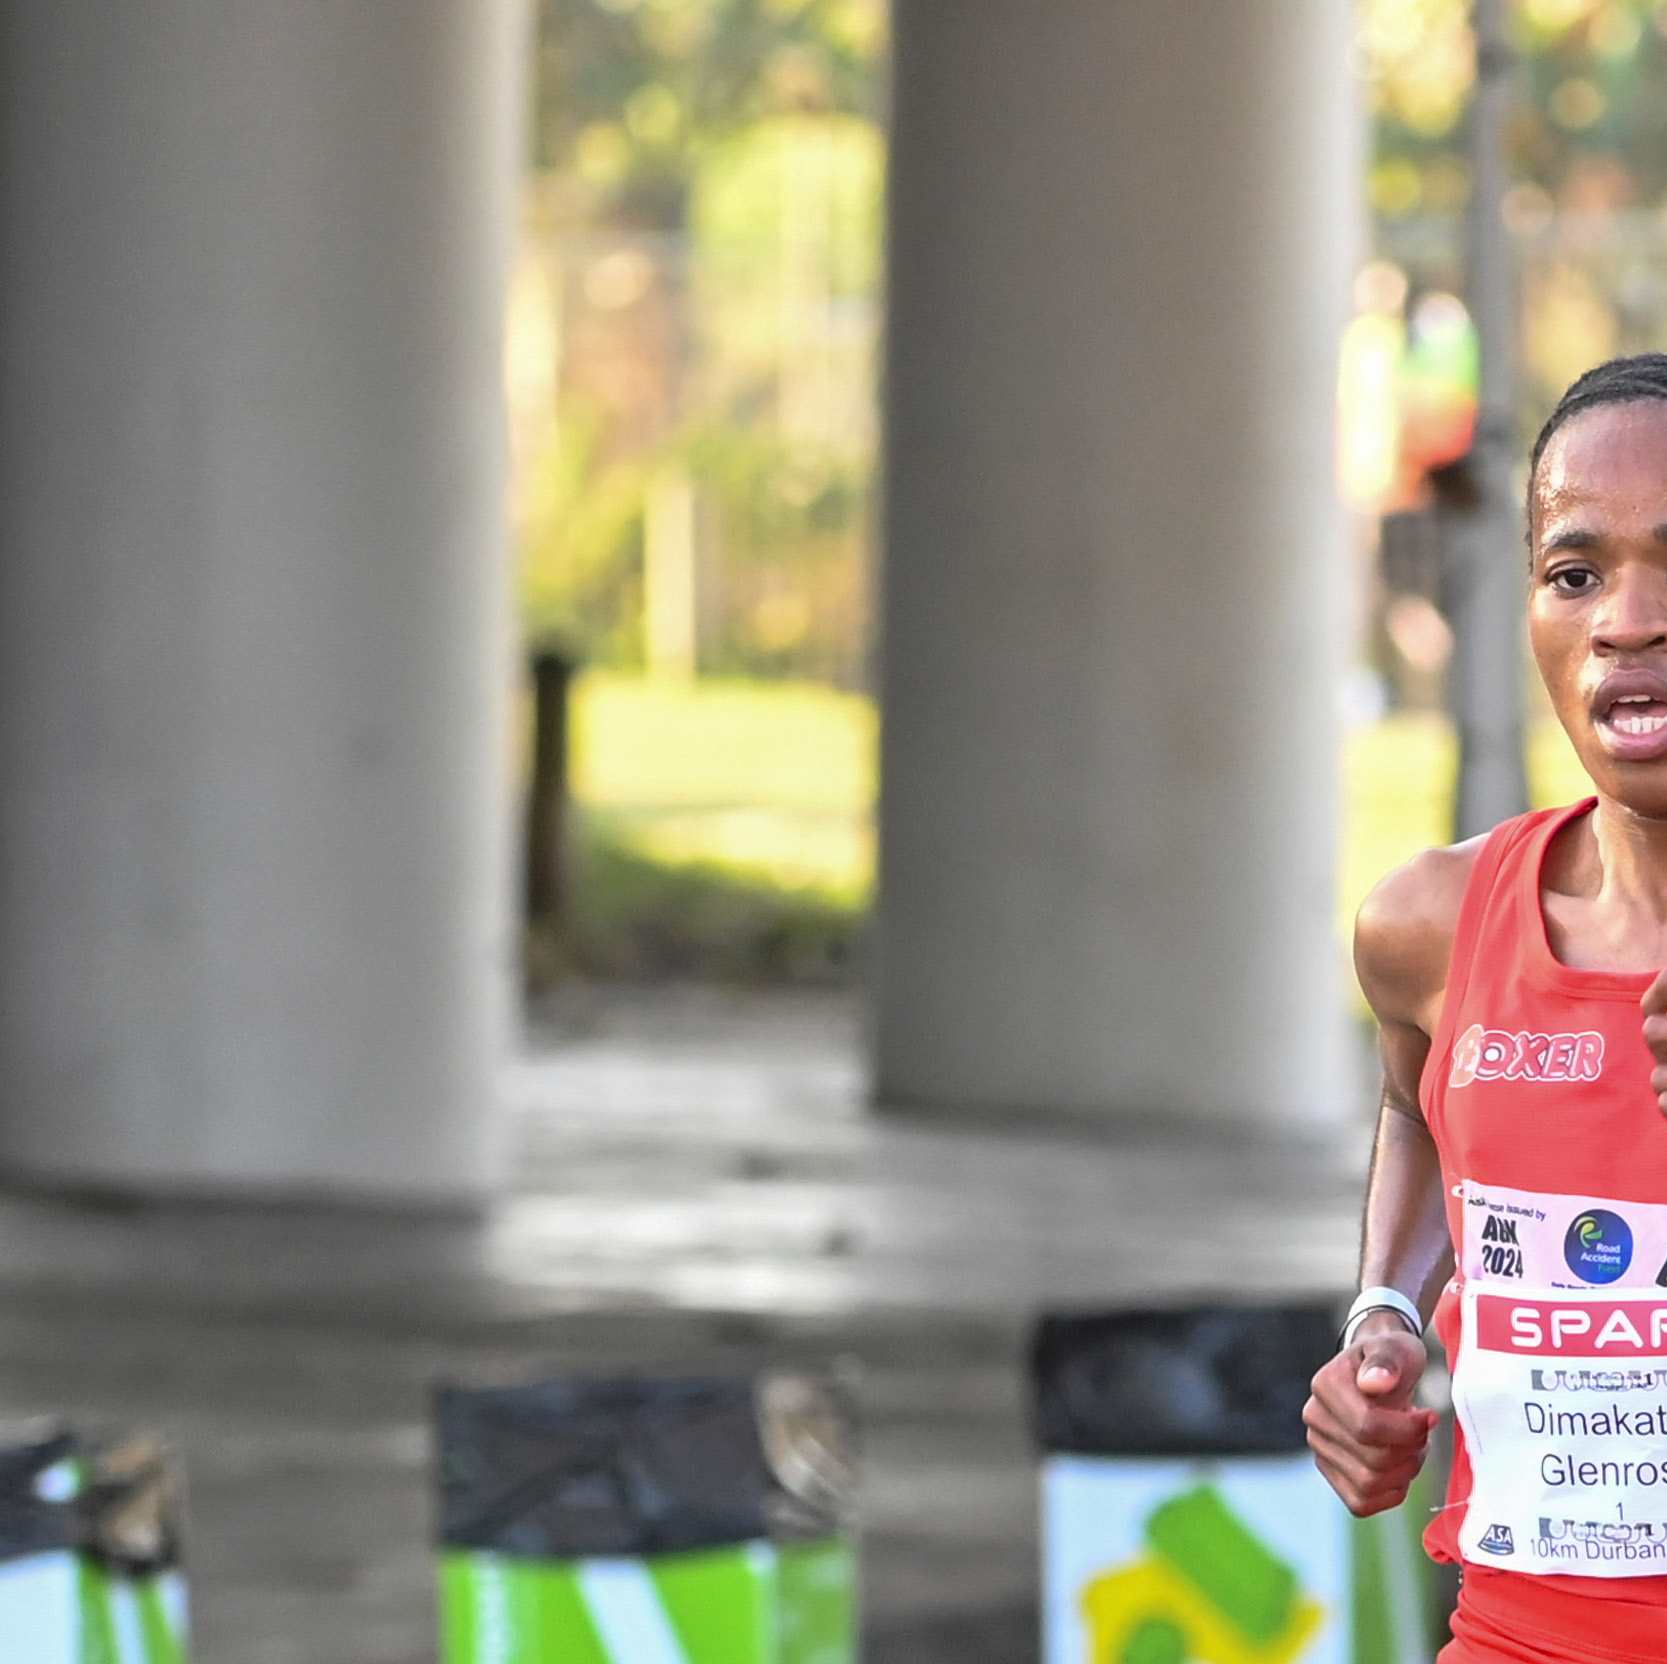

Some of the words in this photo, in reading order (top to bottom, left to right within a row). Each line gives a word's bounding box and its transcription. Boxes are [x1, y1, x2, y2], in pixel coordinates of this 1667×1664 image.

[1597, 1243, 1622, 1254] Road
[1482, 1244, 1524, 1279] 2024
[1580, 1252, 1622, 1264] Accident
[1485, 1526, 1512, 1544] ASA
[1530, 1538, 1579, 1560] 10km
[1586, 1538, 1666, 1560] Durban
